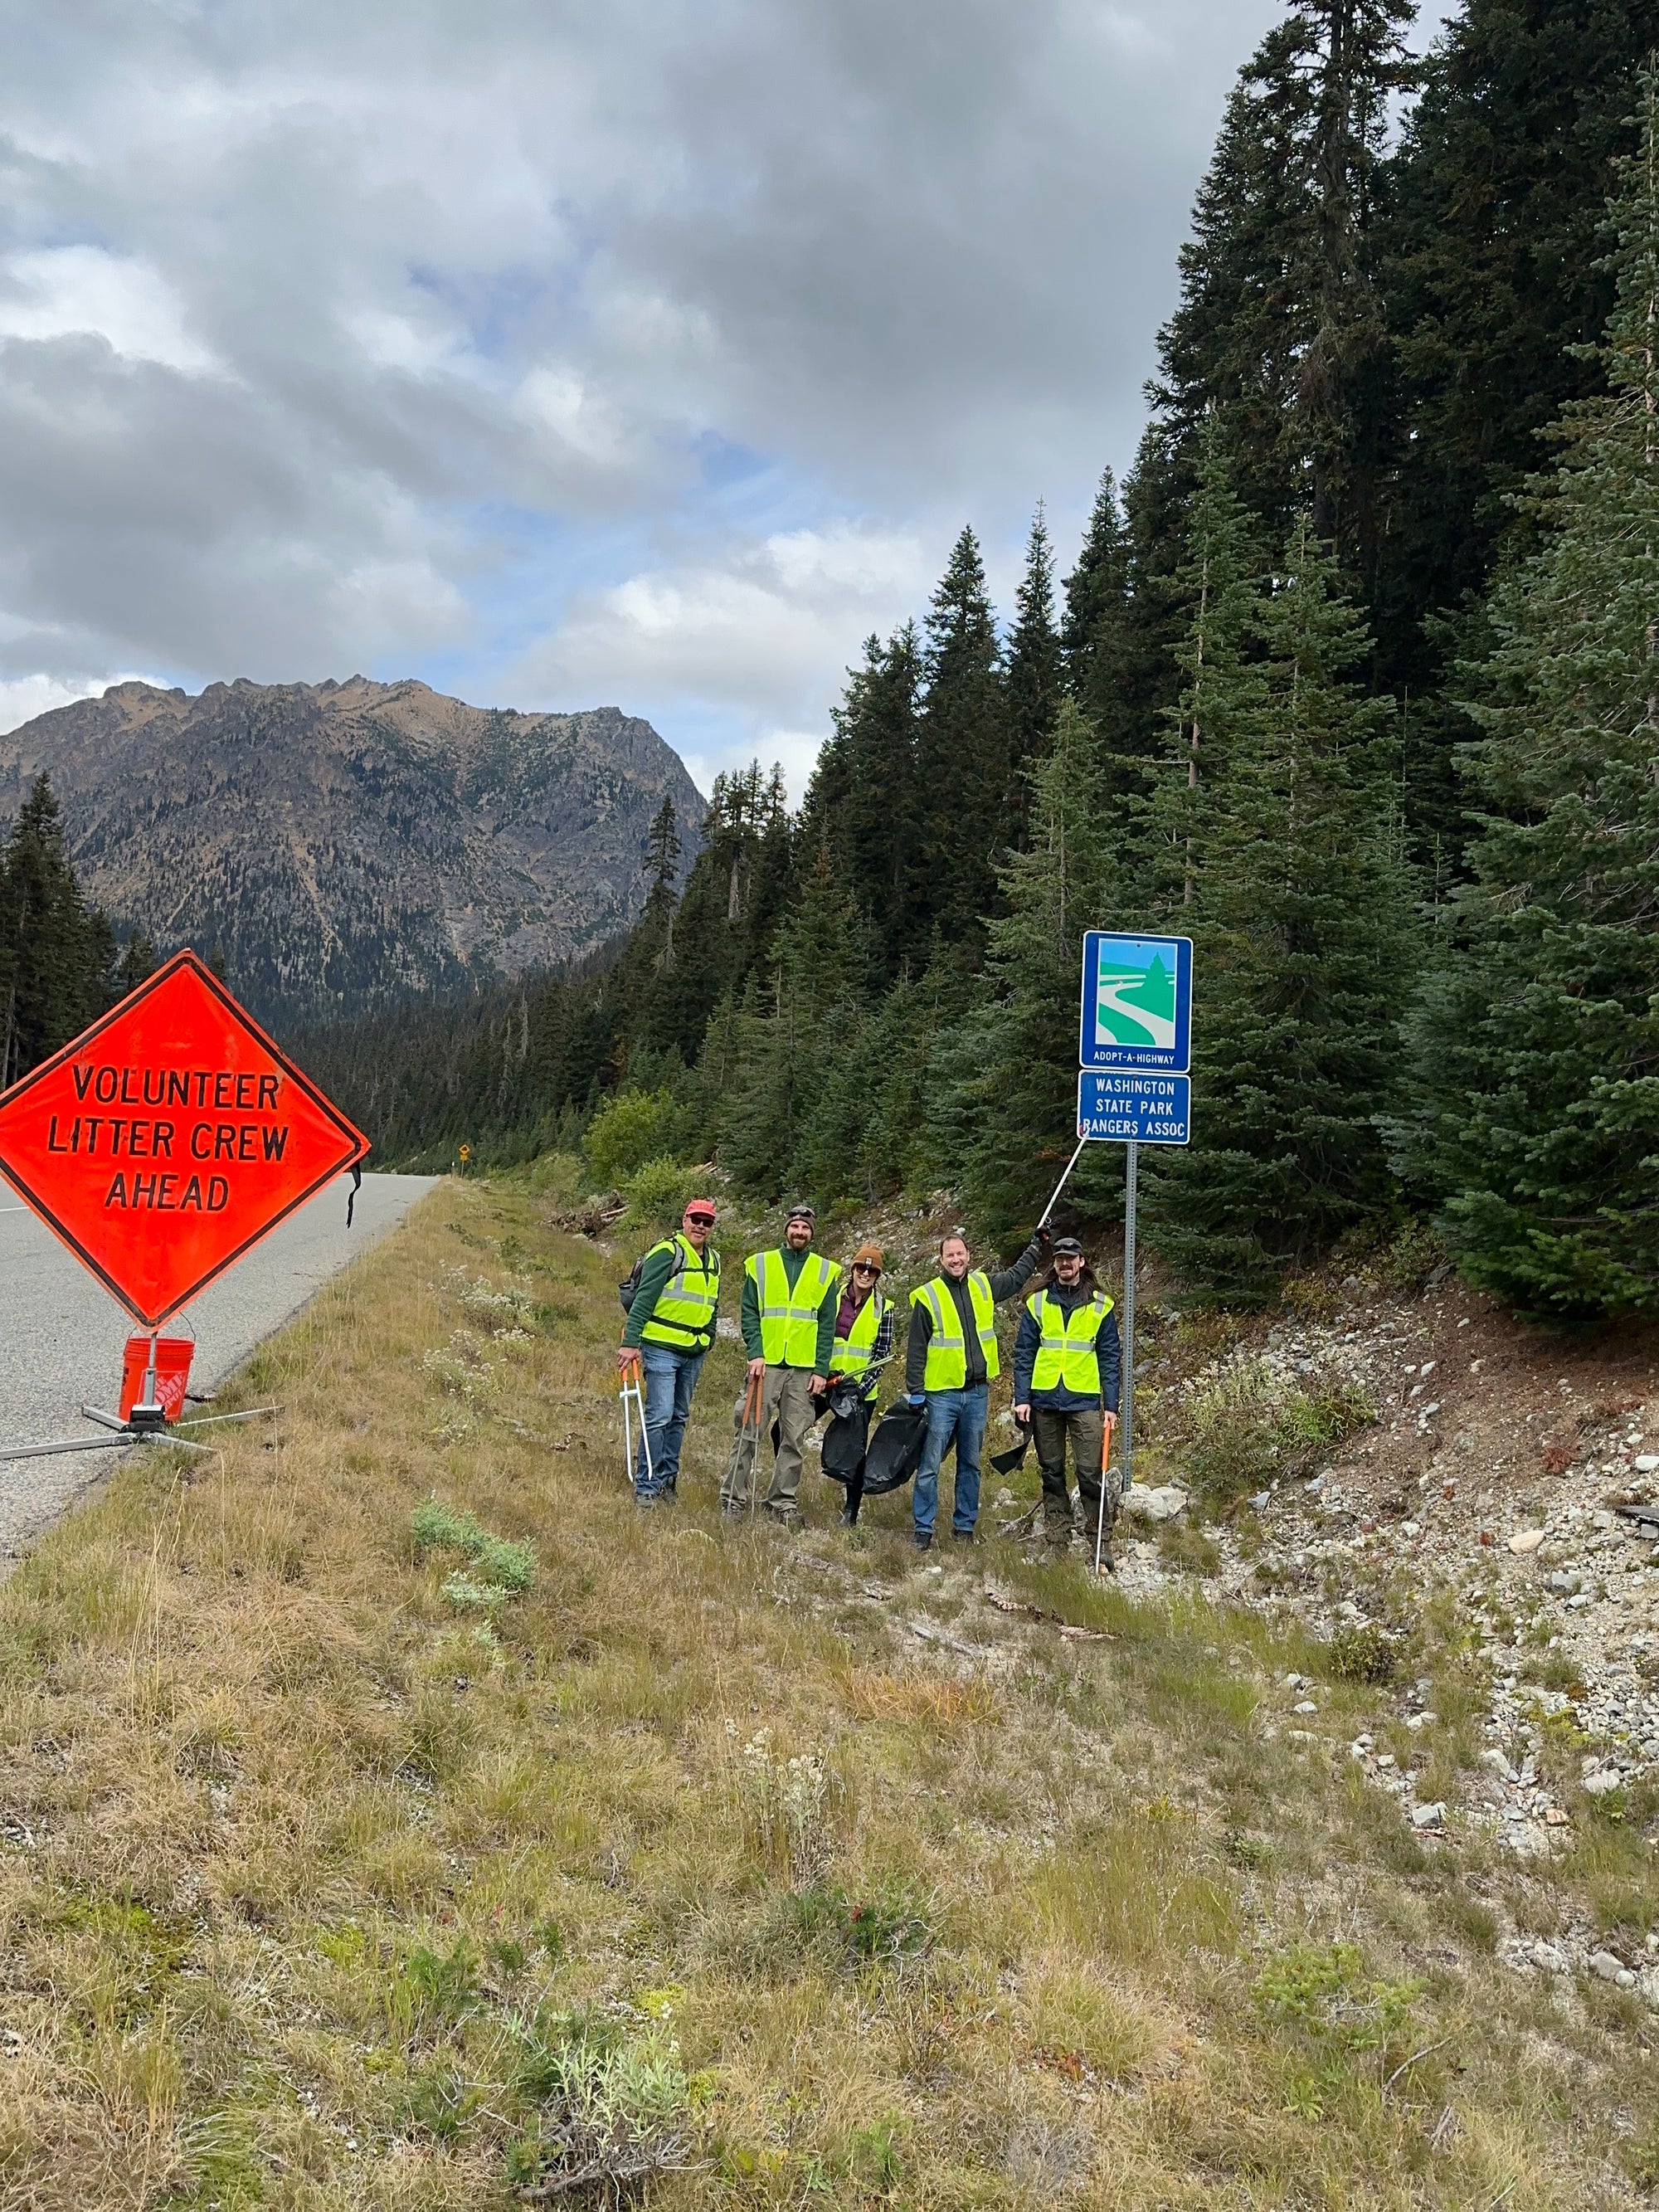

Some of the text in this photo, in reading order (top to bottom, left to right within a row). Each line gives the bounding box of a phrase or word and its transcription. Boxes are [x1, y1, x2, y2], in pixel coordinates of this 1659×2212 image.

[1093, 1050, 1175, 1065] ADOPT-A-HIGHWAY
[72, 1065, 280, 1110] VOLUNTEER
[1096, 1078, 1175, 1095] WASHINGTON
[1096, 1099, 1173, 1116] STATE PARK
[48, 1115, 289, 1162] LITTER CREW
[1082, 1118, 1185, 1137] RANGERS ASSOC
[105, 1172, 229, 1211] AHEAD
[154, 1373, 183, 1405] OME
